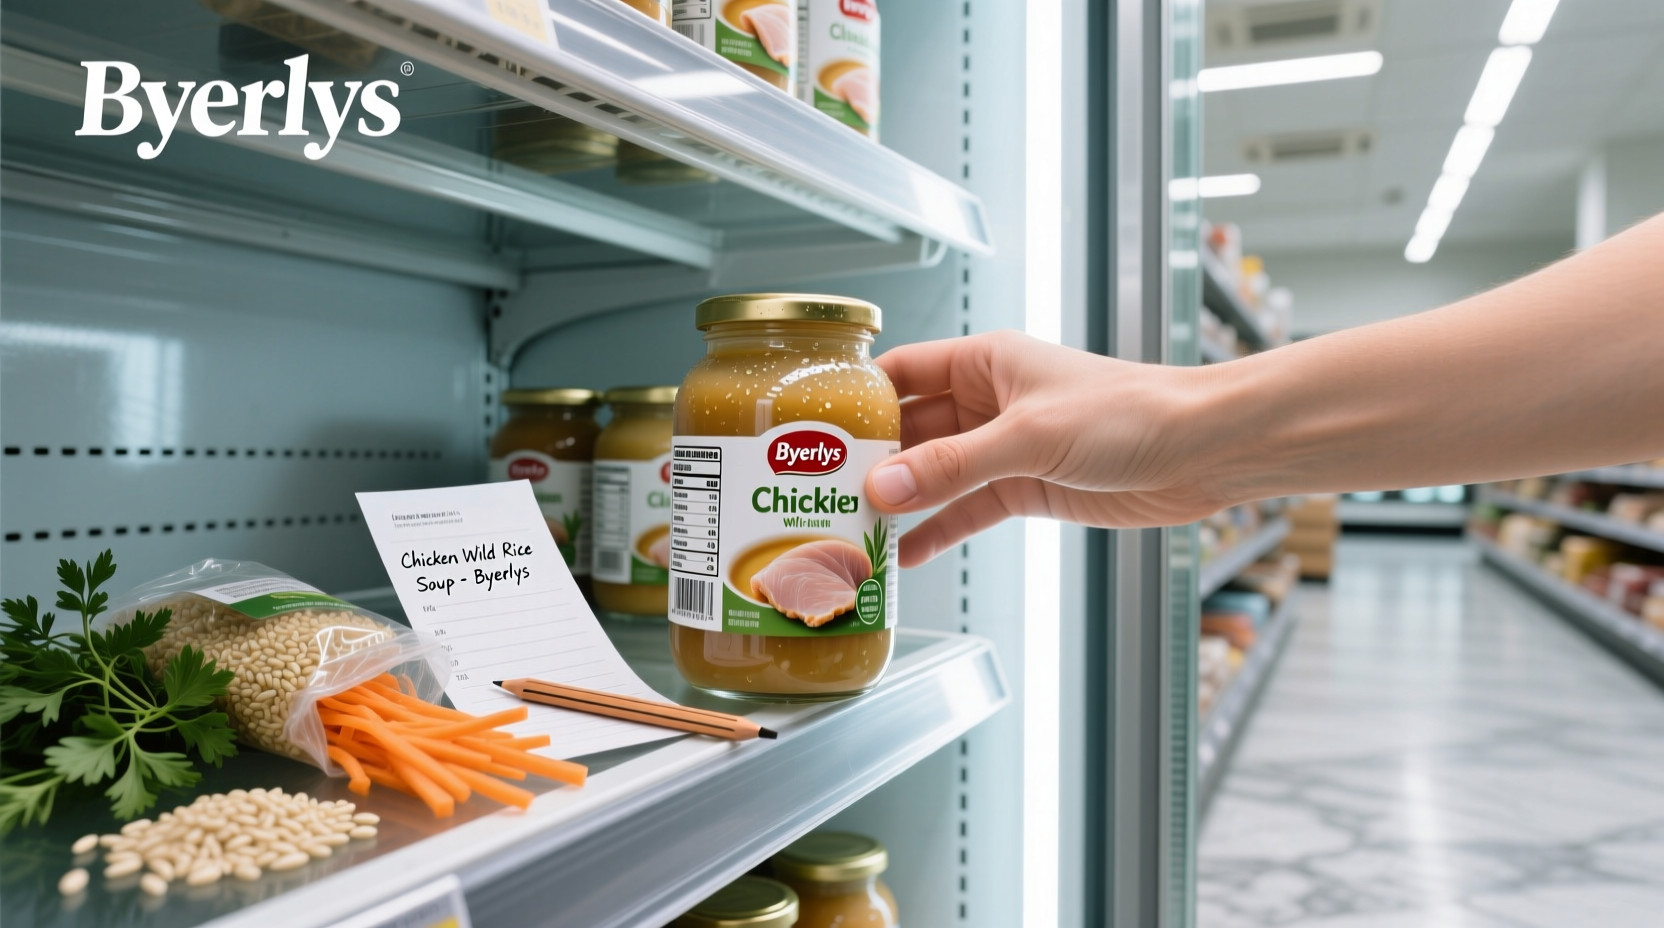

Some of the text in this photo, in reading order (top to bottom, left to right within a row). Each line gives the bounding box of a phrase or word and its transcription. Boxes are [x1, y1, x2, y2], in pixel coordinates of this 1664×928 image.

[775, 441, 842, 466] Byerlys
[401, 541, 533, 569] Chicken Wild Rice
[416, 576, 455, 596] Soup
[474, 564, 530, 592] Byerlys
